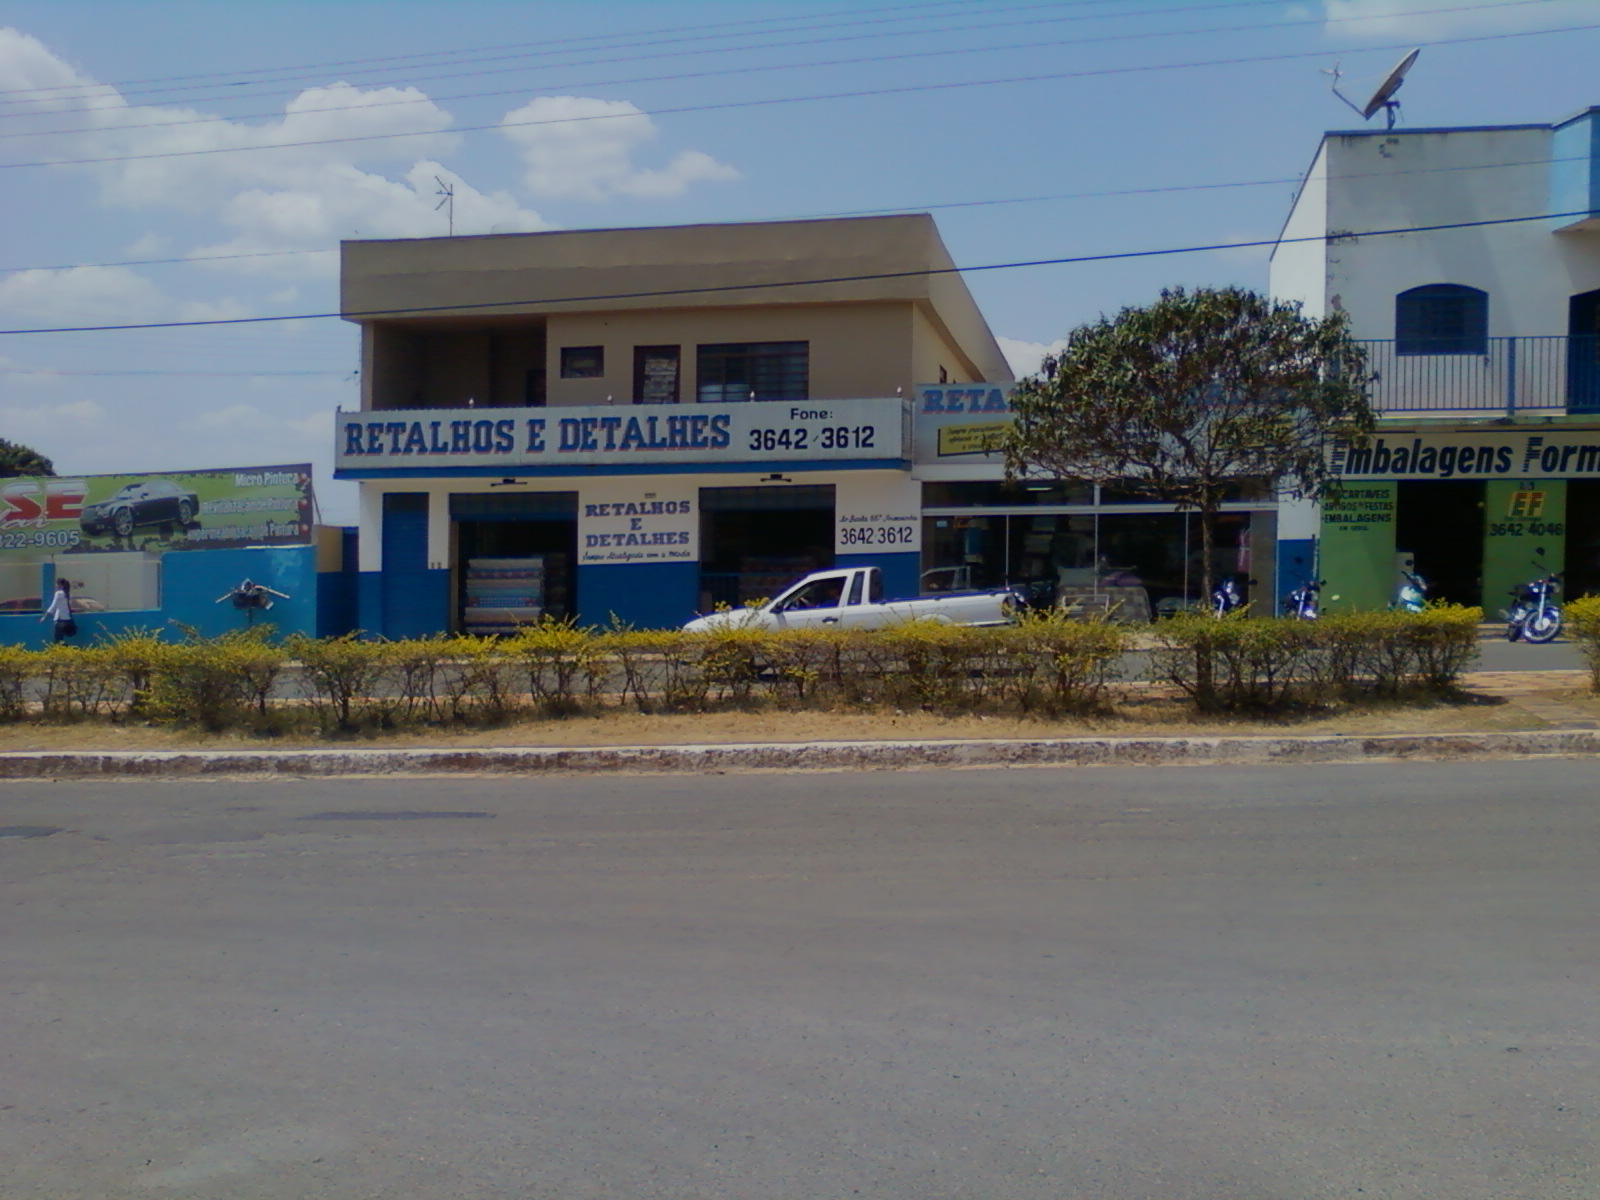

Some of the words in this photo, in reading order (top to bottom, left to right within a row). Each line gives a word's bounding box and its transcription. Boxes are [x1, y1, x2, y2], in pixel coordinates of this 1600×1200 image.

[790, 408, 833, 420] Fone:
[343, 420, 515, 456] RETALHOS
[526, 419, 546, 454] E
[557, 414, 731, 453] DETALHES
[749, 429, 808, 451] 3642
[820, 426, 875, 449] 3612
[1330, 438, 1514, 477] Embalagens
[235, 473, 263, 487] Micro
[264, 472, 299, 486] Pintura
[585, 500, 691, 517] RETALHOS
[1511, 491, 1544, 517] EF
[630, 518, 642, 530] E
[1324, 513, 1392, 524] EMBALAGENS
[840, 527, 874, 545] 3642
[877, 526, 913, 544] 3612
[1490, 523, 1524, 536] 3642
[0, 530, 80, 548] 22-9605
[585, 531, 690, 548] DETALHES
